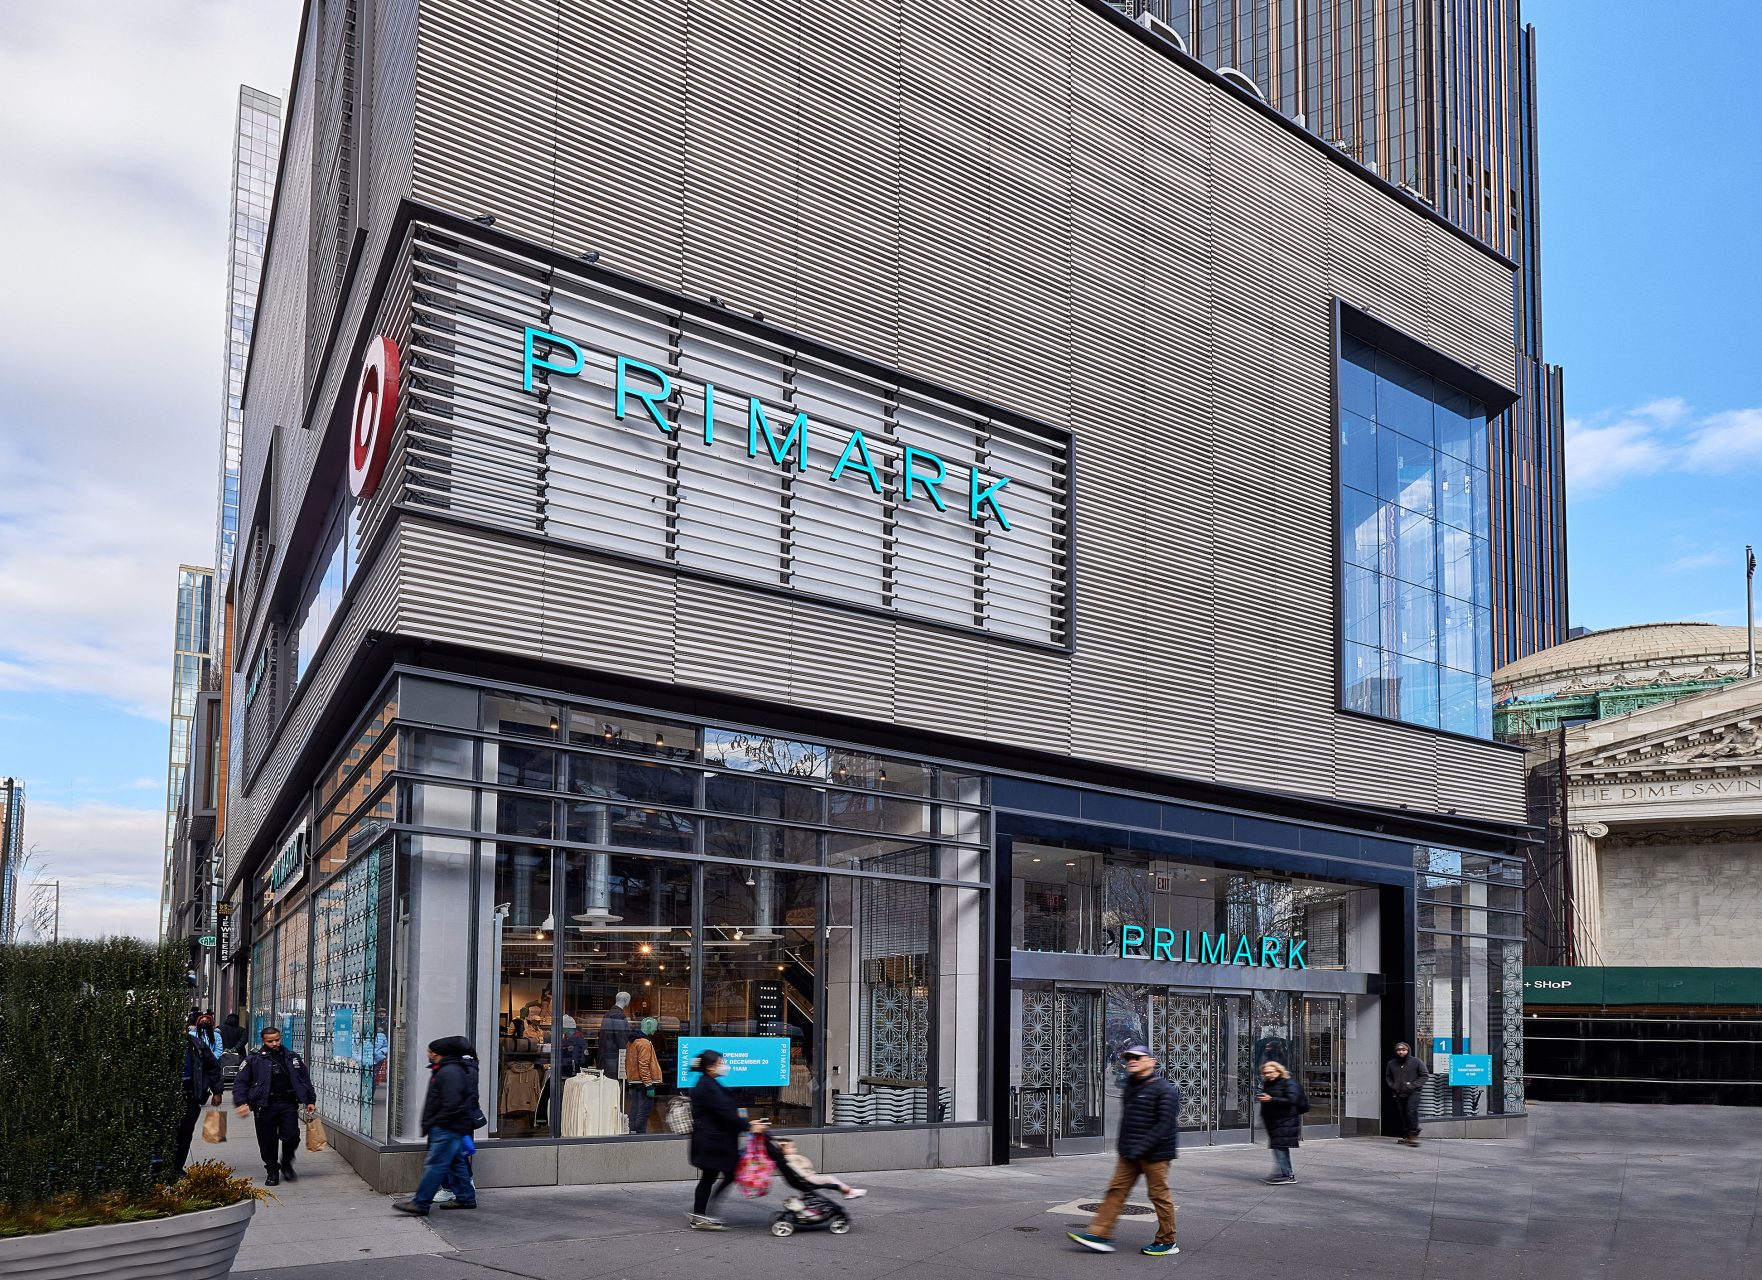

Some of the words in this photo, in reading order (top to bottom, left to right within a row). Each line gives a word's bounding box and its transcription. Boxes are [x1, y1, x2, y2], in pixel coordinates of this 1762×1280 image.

[523, 326, 1012, 531] PRIMARK
[1569, 787, 1613, 802] THE
[1622, 785, 1683, 799] DIME
[1692, 779, 1762, 795] SAVIN
[1157, 877, 1170, 890] EXIT
[221, 915, 231, 961] JEWELERS
[1121, 924, 1308, 970] PRIMARK
[1534, 980, 1572, 989] SHoP
[1439, 1040, 1446, 1051] 1
[681, 1043, 689, 1082] PRIMARK
